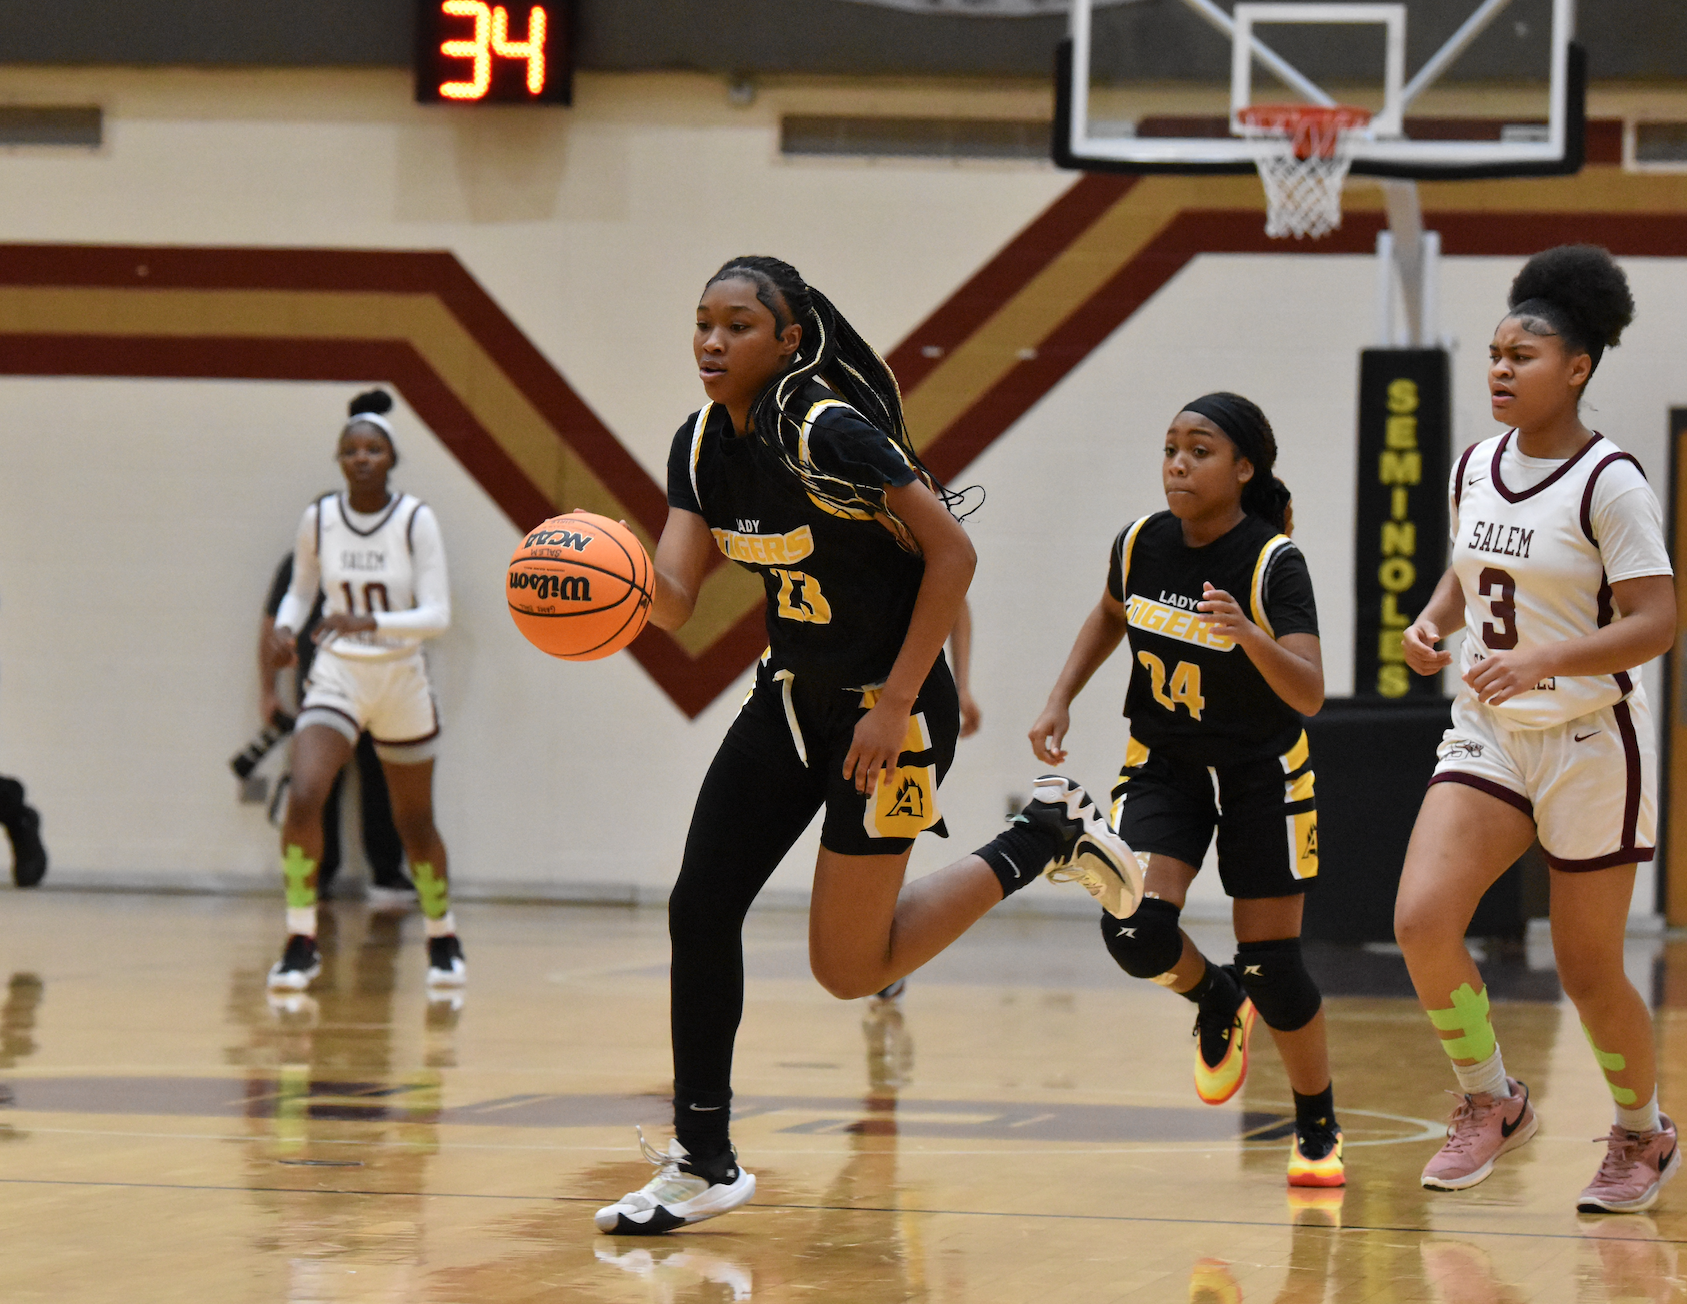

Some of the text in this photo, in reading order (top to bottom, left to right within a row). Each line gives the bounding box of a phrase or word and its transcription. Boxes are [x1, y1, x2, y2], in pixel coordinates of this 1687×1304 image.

[438, 0, 547, 99] 34
[523, 528, 595, 552] NCAA
[530, 547, 563, 559] SALEM
[710, 524, 814, 565] TIGERS
[1377, 377, 1422, 698] SEMINOLES
[1468, 520, 1535, 559] SALEM
[340, 581, 390, 614] 10
[509, 572, 592, 602] Wilson
[1158, 589, 1199, 611] LADY
[1478, 566, 1519, 650] 3
[1137, 650, 1205, 721] 24
[885, 776, 924, 818] A
